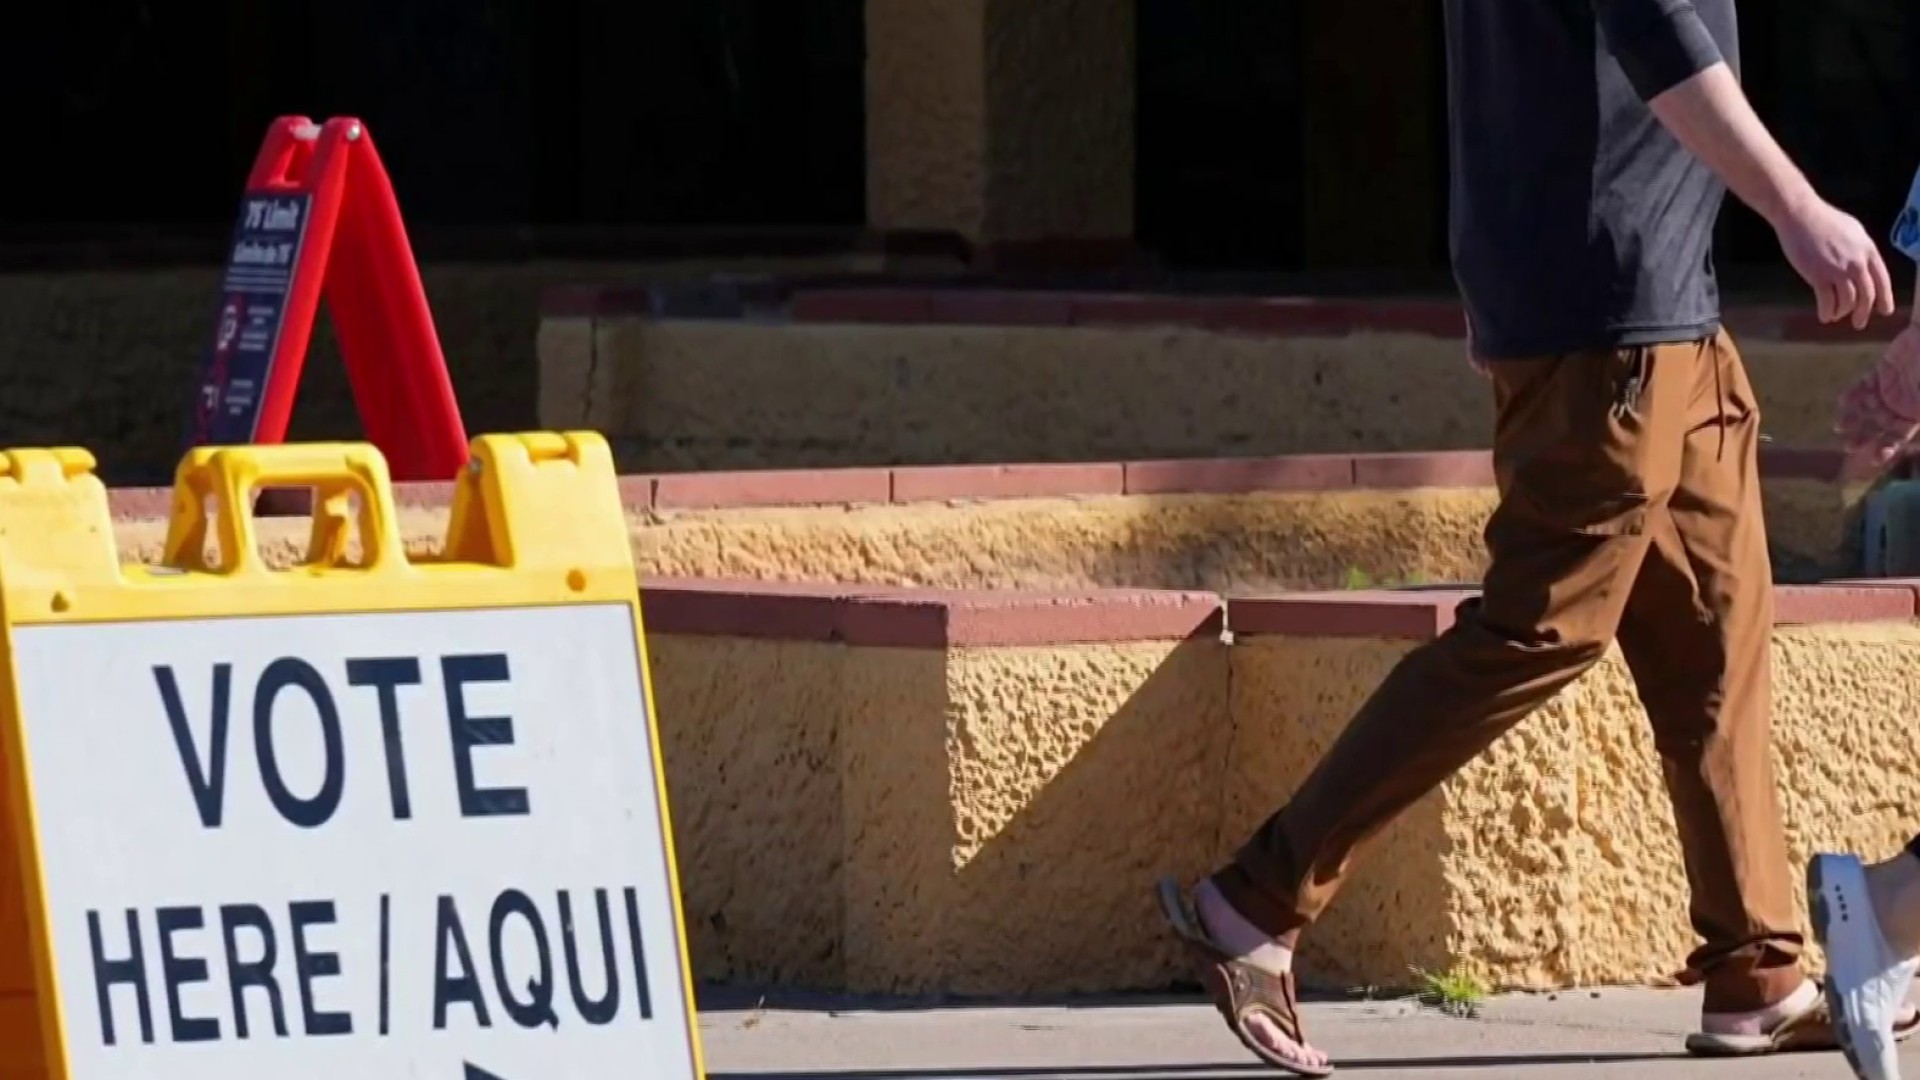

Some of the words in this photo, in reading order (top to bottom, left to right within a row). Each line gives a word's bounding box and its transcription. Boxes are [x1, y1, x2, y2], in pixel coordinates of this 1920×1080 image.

[153, 653, 530, 828] VOTE
[87, 900, 353, 1045] HERE
[379, 894, 390, 1036] /
[433, 887, 653, 1031] AQUI
